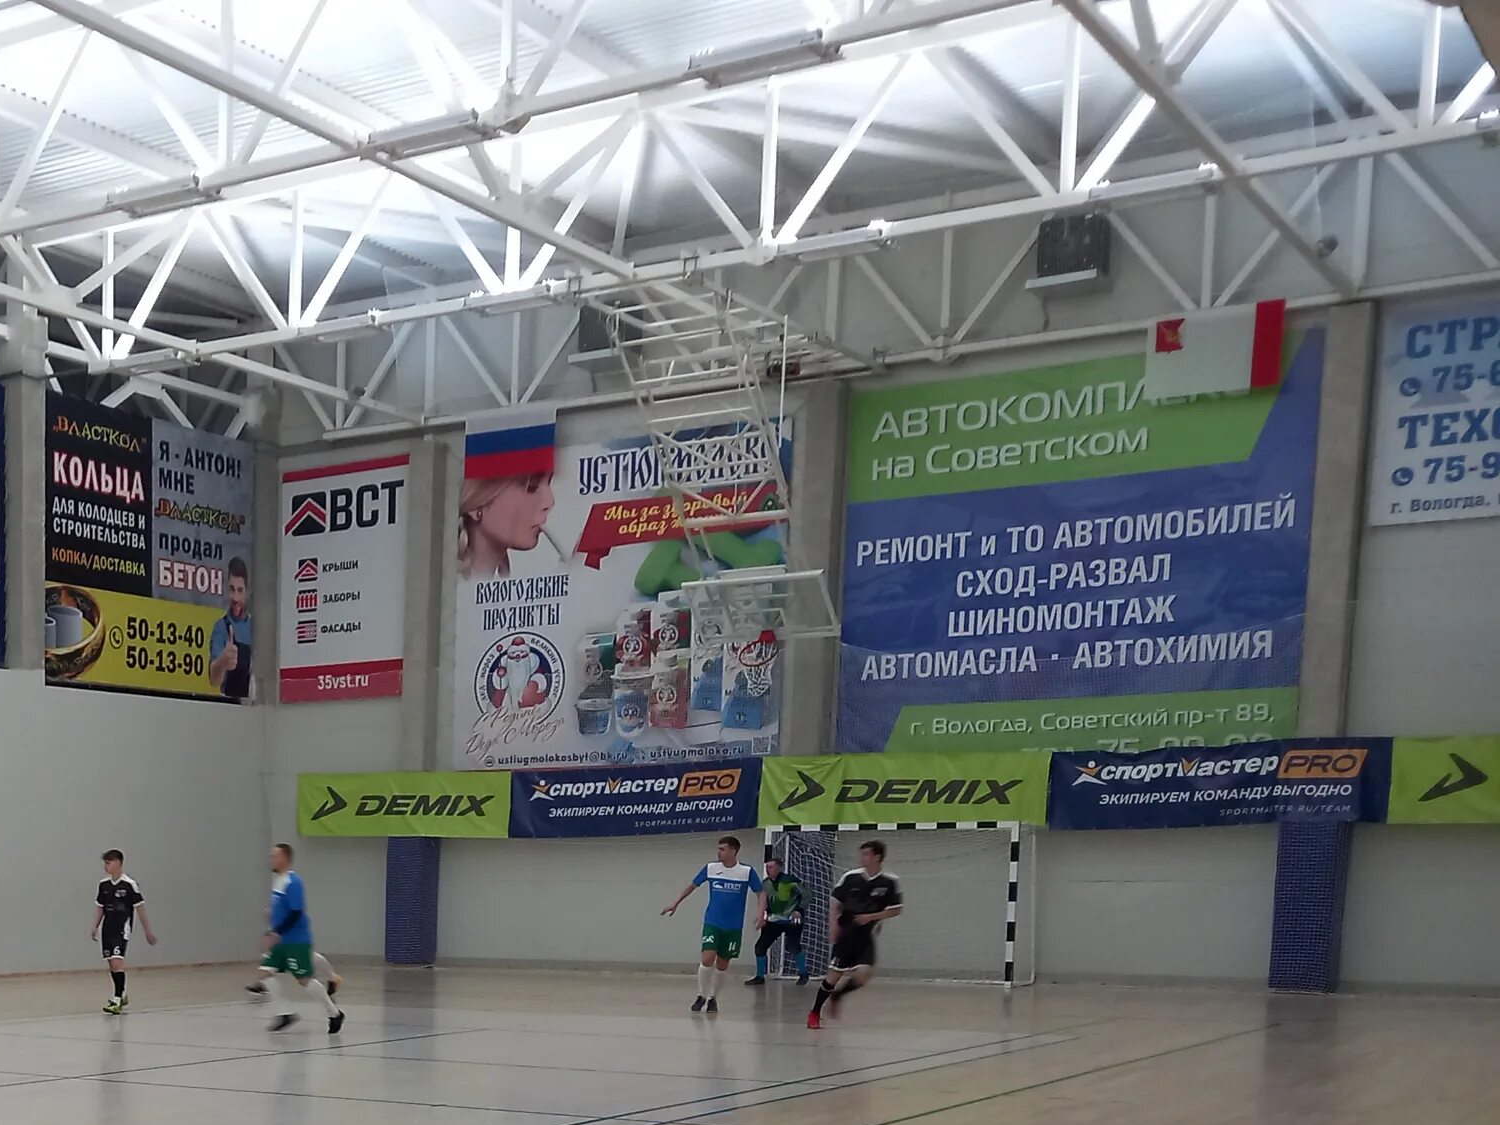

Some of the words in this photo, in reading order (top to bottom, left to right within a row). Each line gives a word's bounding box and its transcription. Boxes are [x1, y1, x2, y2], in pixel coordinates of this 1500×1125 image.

[1405, 316, 1500, 360] СТР
[872, 378, 1215, 442] АВТОКОМПЛ
[159, 440, 171, 462] Я
[184, 451, 242, 479] АНТОН!
[872, 453, 914, 481] на
[925, 427, 1148, 475] Советском
[52, 451, 145, 504] КОЛЬЦА
[158, 467, 195, 495] МНЕ
[52, 496, 75, 516] ДЛЯ
[78, 501, 136, 528] КОЛОДЦЕВ
[138, 514, 146, 529] И
[329, 479, 405, 533] ВСТ
[604, 506, 638, 522] Мы
[640, 507, 661, 521] за
[53, 516, 146, 550] СТРОИТЕЛЬСТВА
[619, 516, 668, 539] образ
[856, 530, 972, 567] РЕМОНТ
[980, 536, 997, 556] и
[1007, 525, 1044, 554] ТО
[1053, 493, 1296, 549] АВТОМОБИЛЕЙ
[158, 532, 223, 560] продал
[52, 547, 146, 576] КОПКА/ДОСТАВКА
[322, 560, 359, 573] КРЫШИ
[956, 553, 1171, 599] СХОД-РАЗВАЛ
[158, 558, 224, 595] БЕТОН
[476, 574, 570, 605] ВОЛОГОДСКИЕ
[322, 591, 361, 604] ЗАБОРЫ
[320, 621, 362, 635] ФАСАДЫ
[483, 603, 560, 632] ПРОДУКТЫ
[948, 594, 1177, 638] ШИНОМОНТАЖ
[126, 616, 204, 649] 50-13-40
[126, 646, 204, 676] 50-13-90
[861, 645, 1037, 681] АВТОМАСЛА
[1072, 630, 1273, 671] АВТОХИМИЯ
[317, 674, 369, 691] 35vst.ru
[910, 722, 926, 736] г.
[931, 715, 1033, 737] Вологда,
[1040, 708, 1168, 732] Советский
[1175, 708, 1229, 728] пр-т
[1236, 703, 1275, 724] 89,
[1284, 753, 1357, 774] PRO
[683, 773, 736, 792] PRO
[835, 778, 1024, 806] DEMIX
[1099, 791, 1190, 806] ЭКИПИРУЕМ
[1193, 786, 1272, 803] КОМАНДУ
[1273, 784, 1352, 798] ВЫГОДНО
[354, 794, 496, 817] DEMIX
[549, 806, 614, 818] ЭКИПИРУЕМ
[617, 803, 673, 816] КОМАНДУ
[675, 799, 733, 812] ВЫГОДНО
[113, 945, 121, 955] 6
